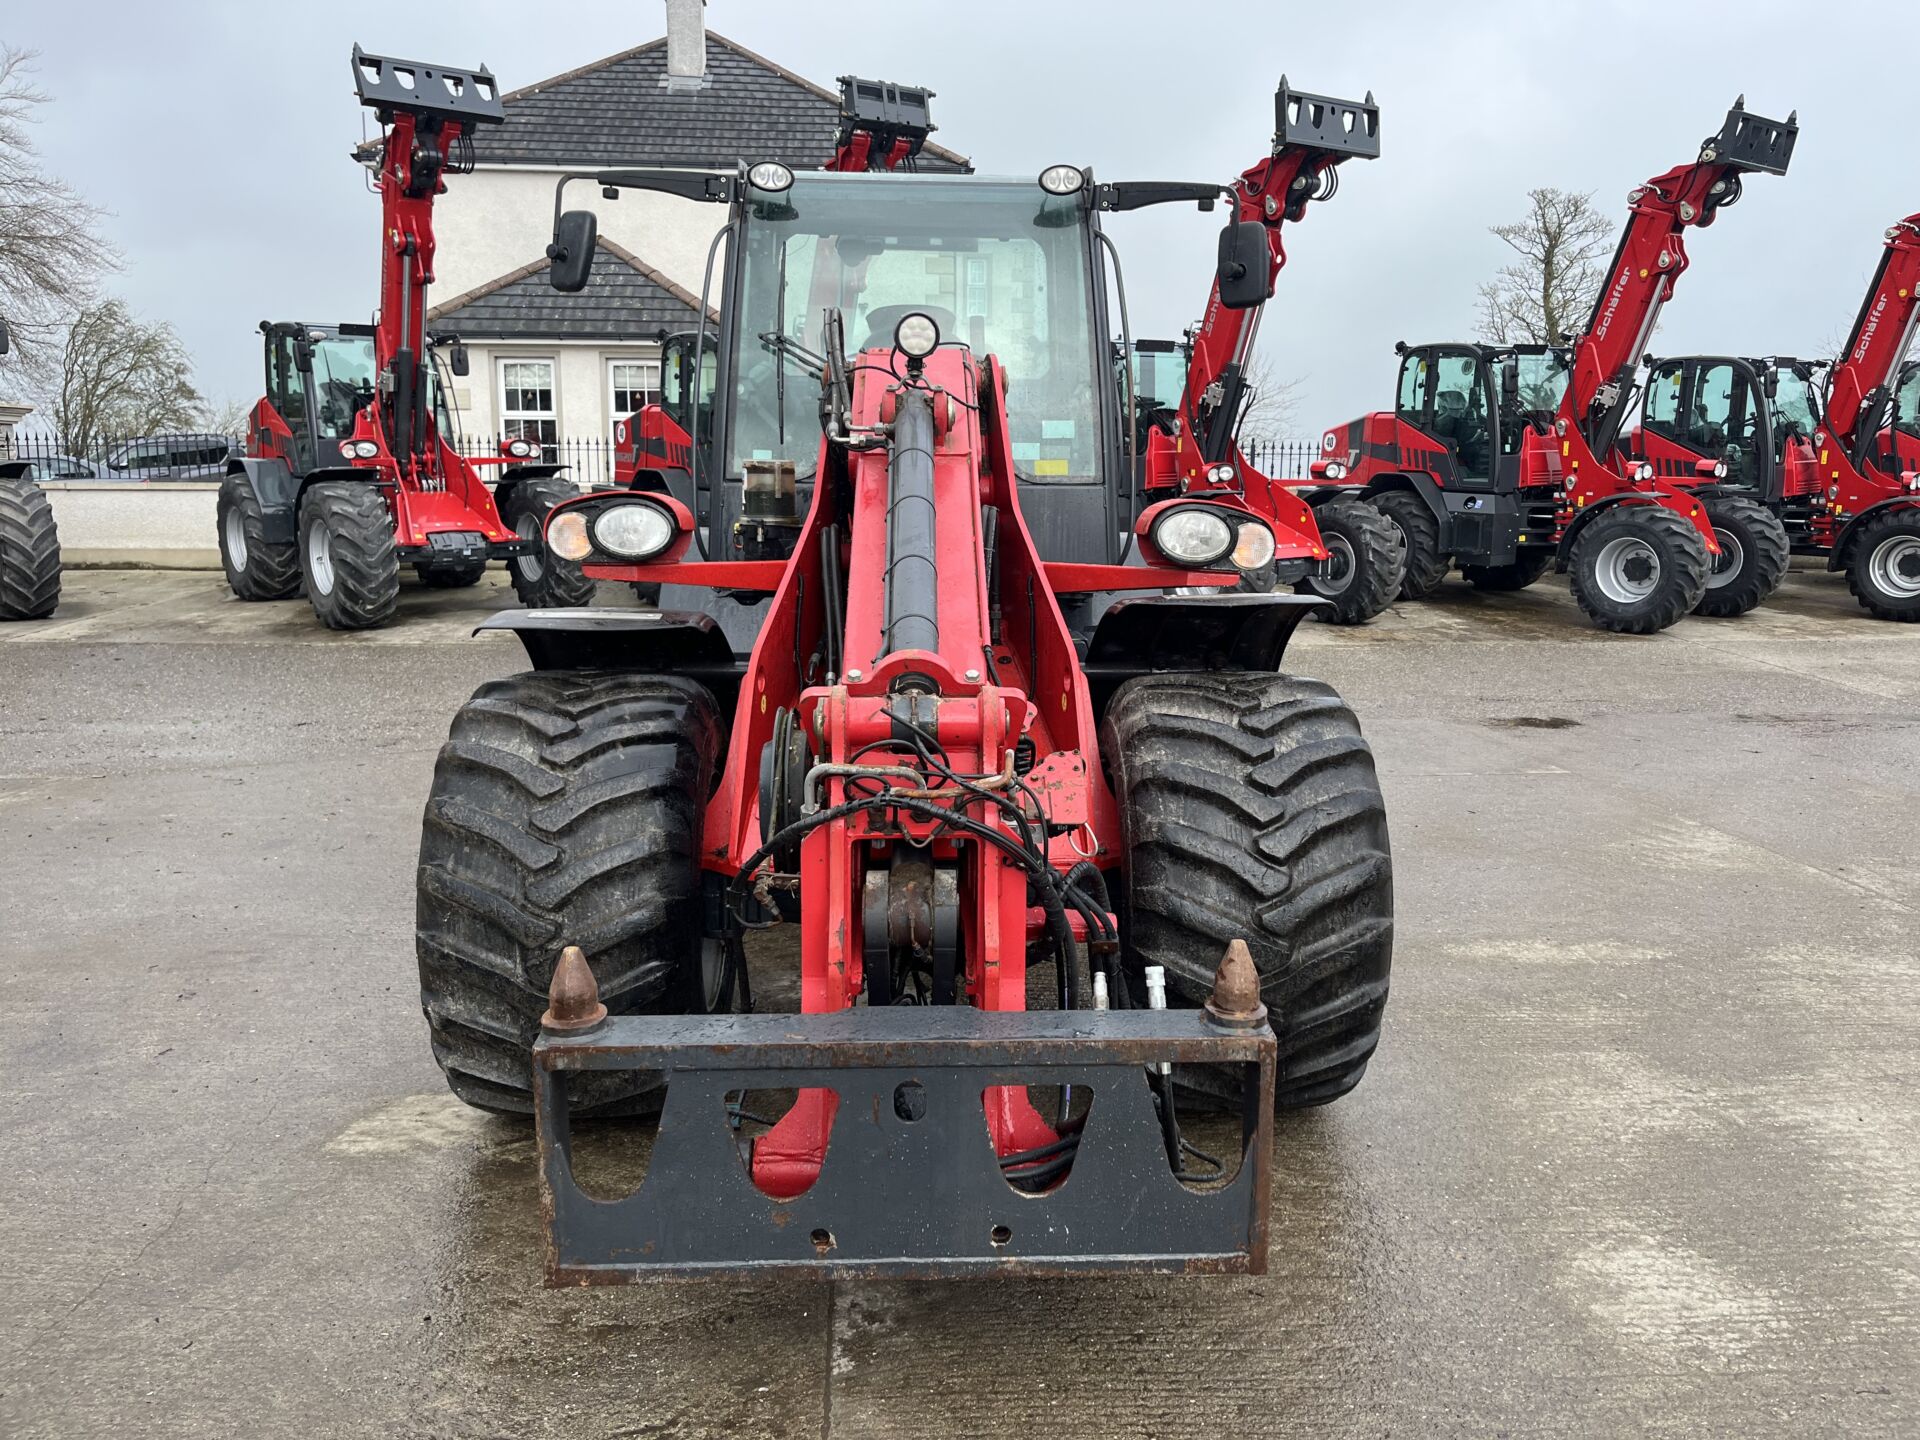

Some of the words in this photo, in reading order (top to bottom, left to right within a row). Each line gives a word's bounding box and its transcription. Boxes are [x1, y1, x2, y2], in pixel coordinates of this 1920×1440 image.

[1597, 267, 1630, 341] Schäffer
[1855, 294, 1887, 364] Schäffer
[1326, 437, 1334, 448] 40
